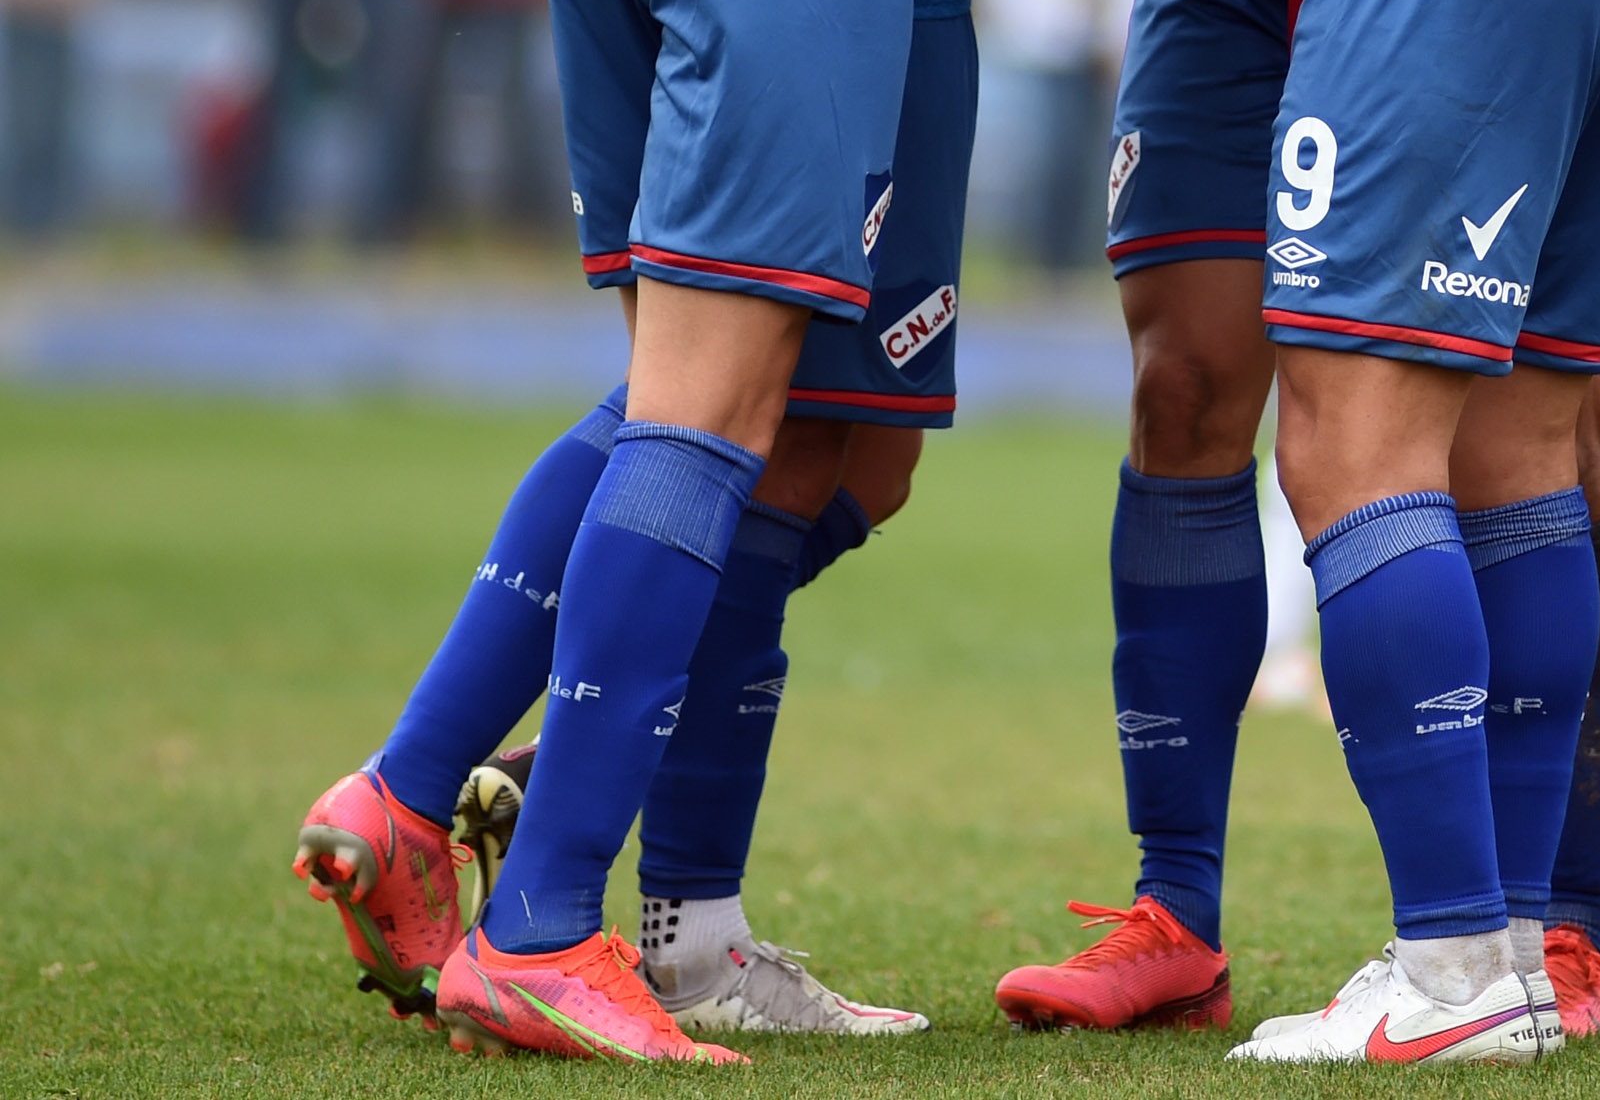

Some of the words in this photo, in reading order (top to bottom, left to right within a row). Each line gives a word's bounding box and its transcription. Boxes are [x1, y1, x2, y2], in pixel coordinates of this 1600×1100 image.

[1276, 116, 1338, 231] 9
[1272, 270, 1320, 289] umbro
[1421, 260, 1530, 307] Rexona
